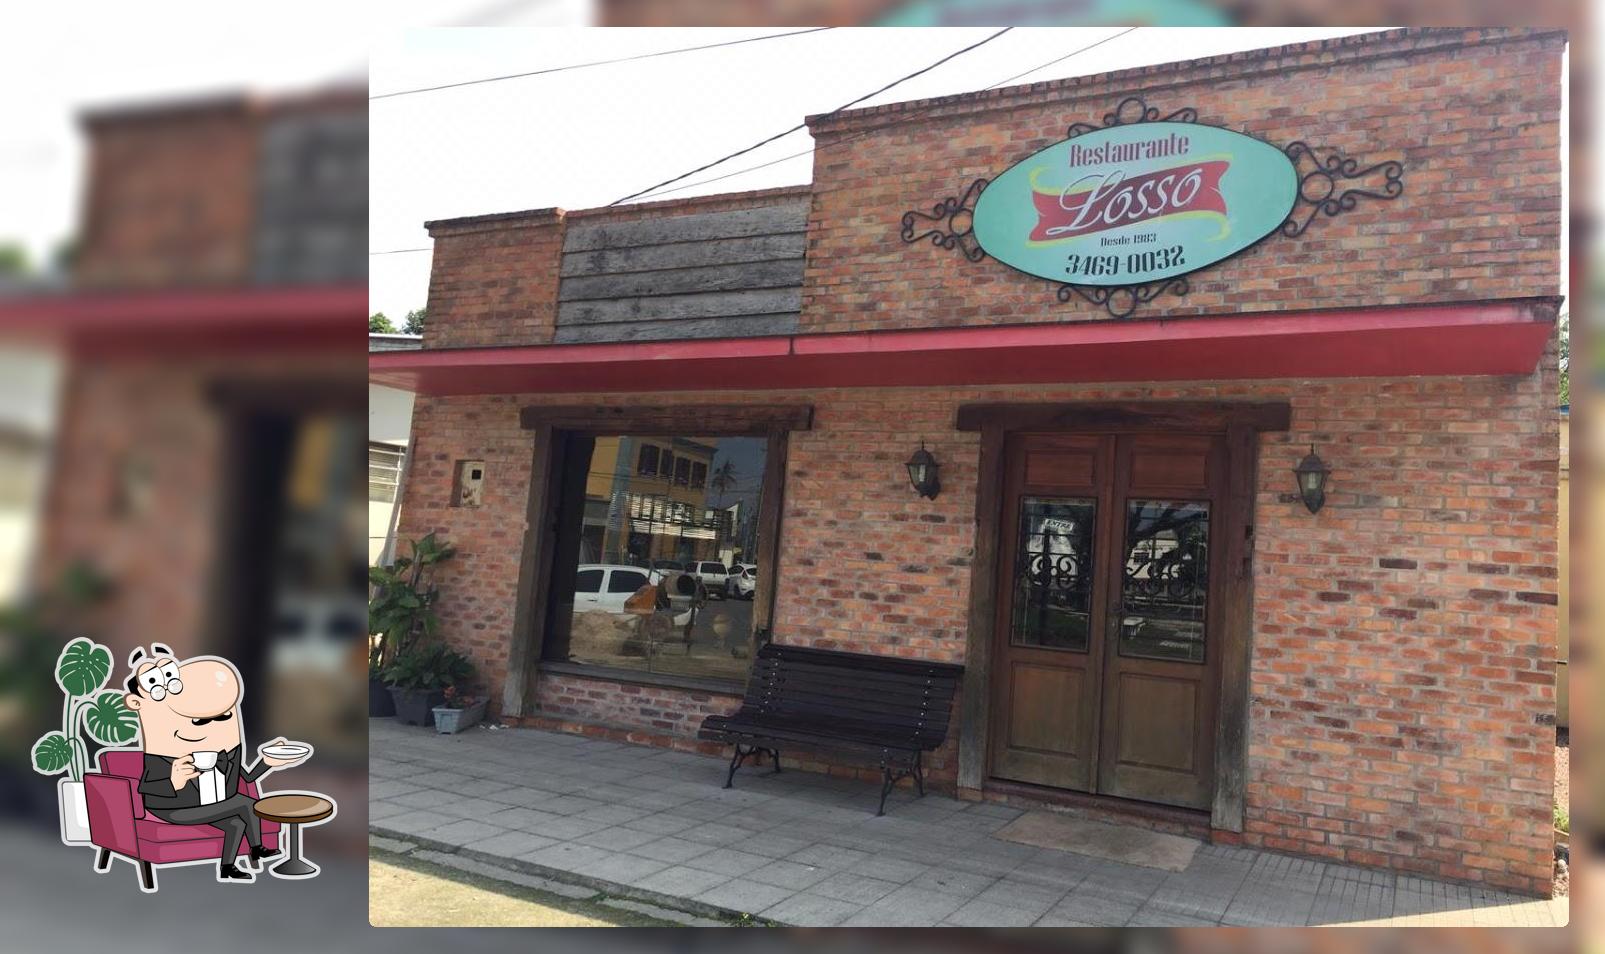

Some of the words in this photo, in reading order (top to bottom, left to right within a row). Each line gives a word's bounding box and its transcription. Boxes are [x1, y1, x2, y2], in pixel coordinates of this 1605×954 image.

[1070, 133, 1189, 168] Restaurante
[1046, 169, 1203, 235] Losso
[1100, 236, 1130, 247] Desde
[1133, 233, 1157, 244] 1983
[1065, 245, 1186, 276] 3469-0032
